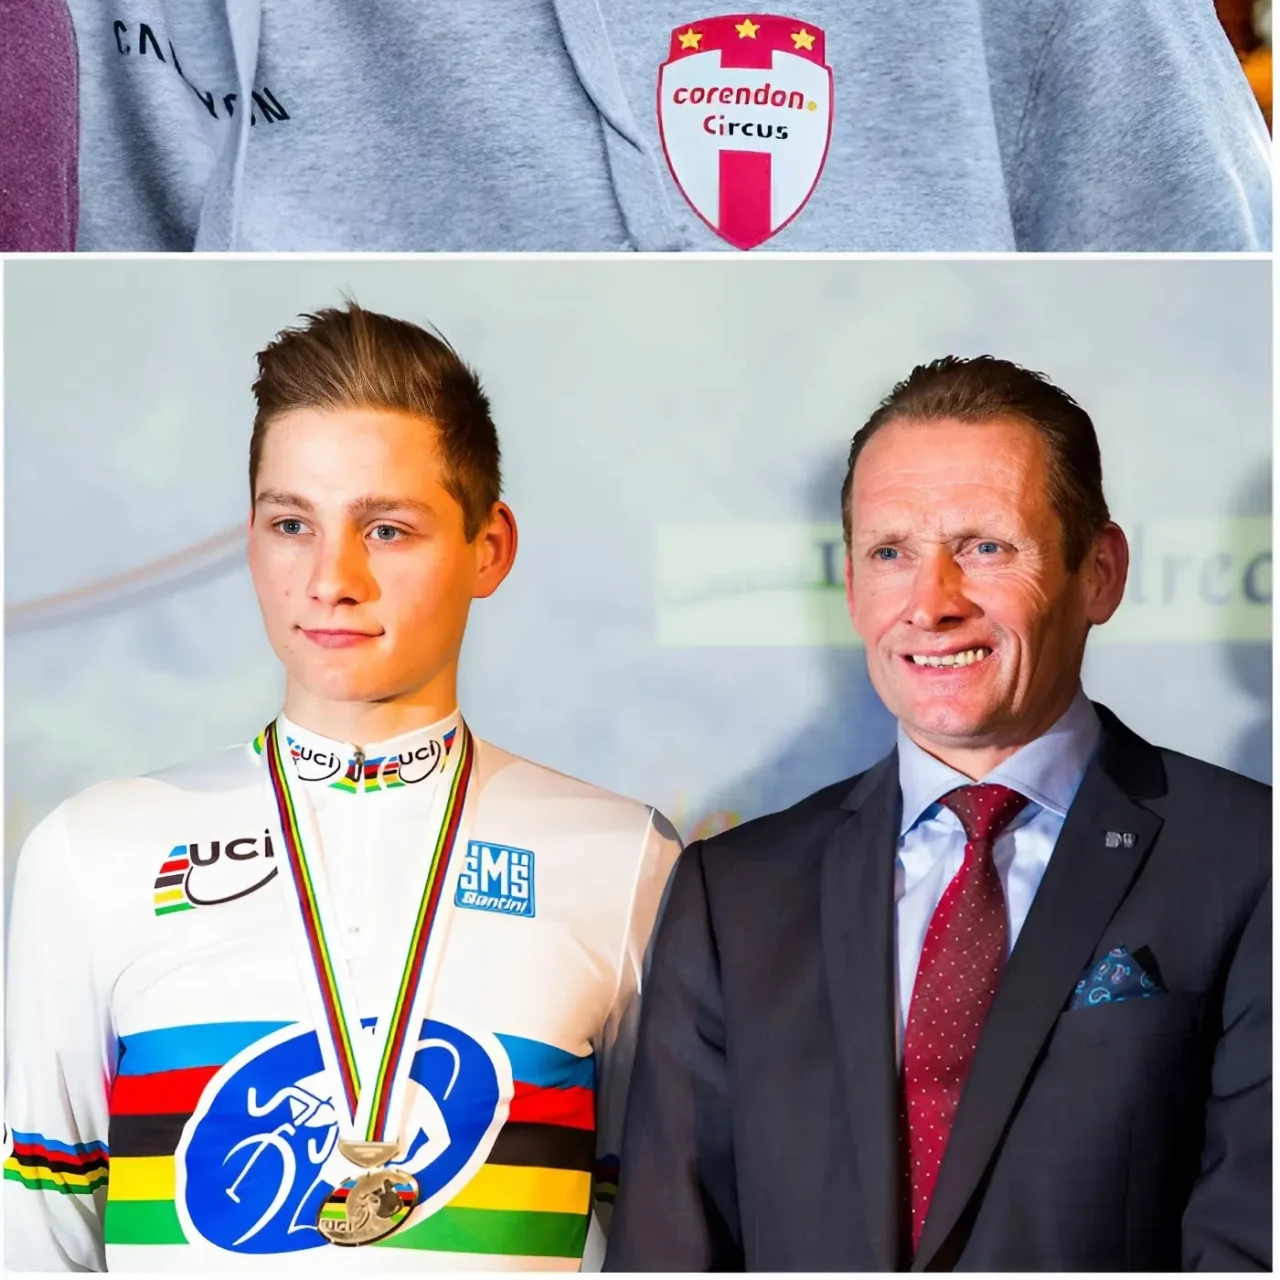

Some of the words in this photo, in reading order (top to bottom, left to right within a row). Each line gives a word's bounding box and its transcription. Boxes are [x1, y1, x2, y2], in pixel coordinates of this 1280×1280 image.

[113, 19, 291, 126] CAYN
[703, 114, 789, 140] Circus
[460, 845, 529, 899] SMS
